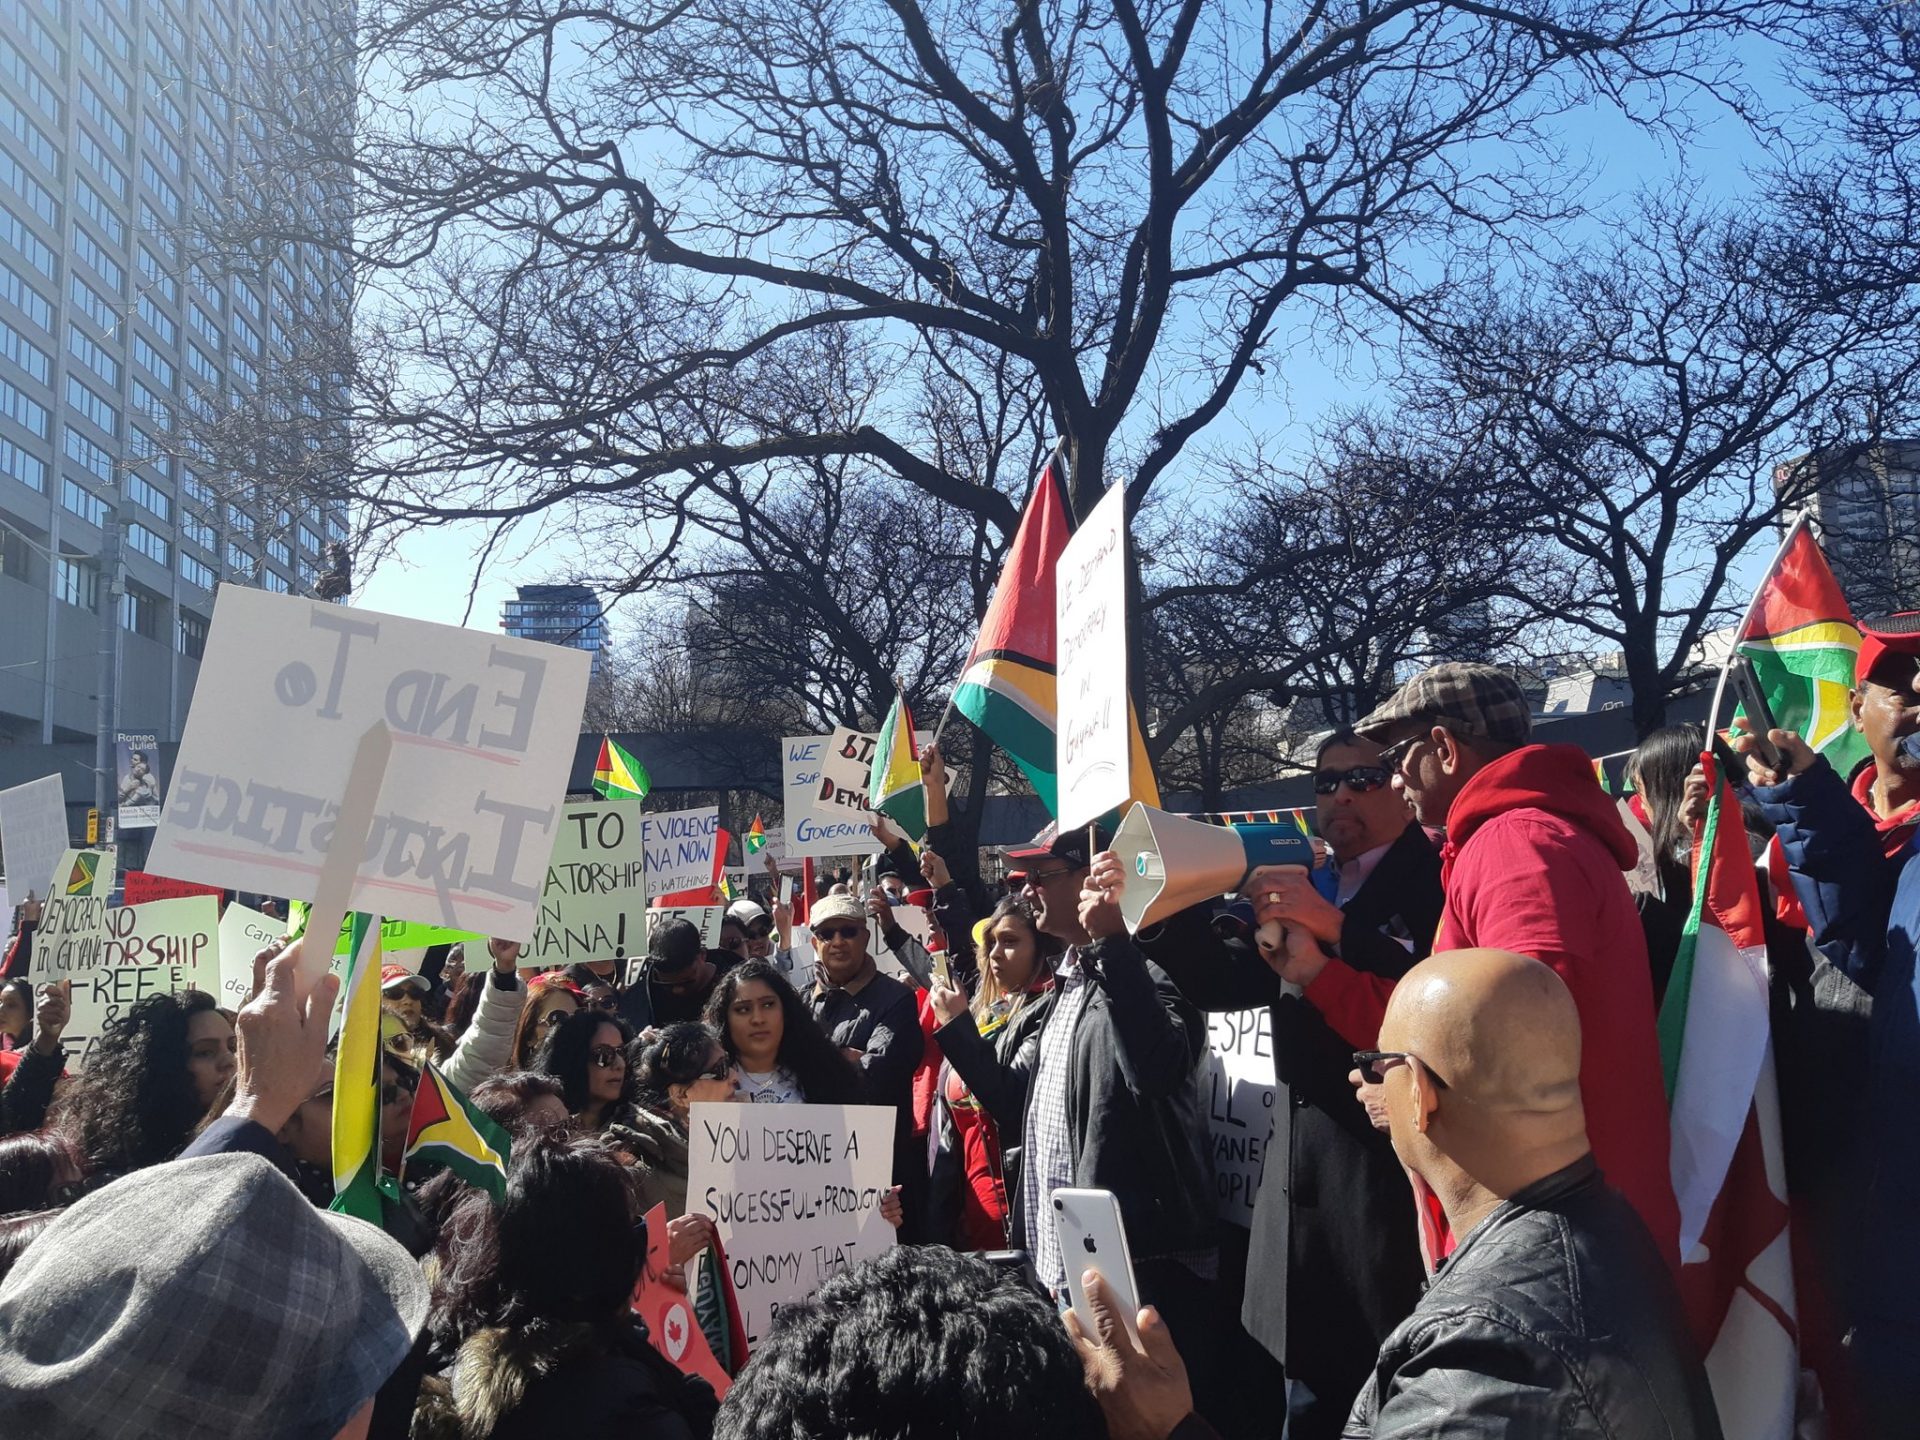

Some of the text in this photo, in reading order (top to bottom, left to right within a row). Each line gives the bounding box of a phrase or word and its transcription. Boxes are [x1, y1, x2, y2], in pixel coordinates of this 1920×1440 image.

[1080, 671, 1091, 700] IN
[117, 733, 156, 743] Romeo
[129, 741, 158, 751] Juliet
[789, 743, 821, 762] WE
[567, 812, 624, 850] TO
[656, 814, 720, 841] VIOLENCE
[676, 837, 713, 867] NOW
[646, 873, 710, 894] IS WATCHING
[37, 883, 107, 936] DEMOCRACY
[37, 934, 102, 974] in GUYANA
[703, 1119, 859, 1166] YOU DESERVE A
